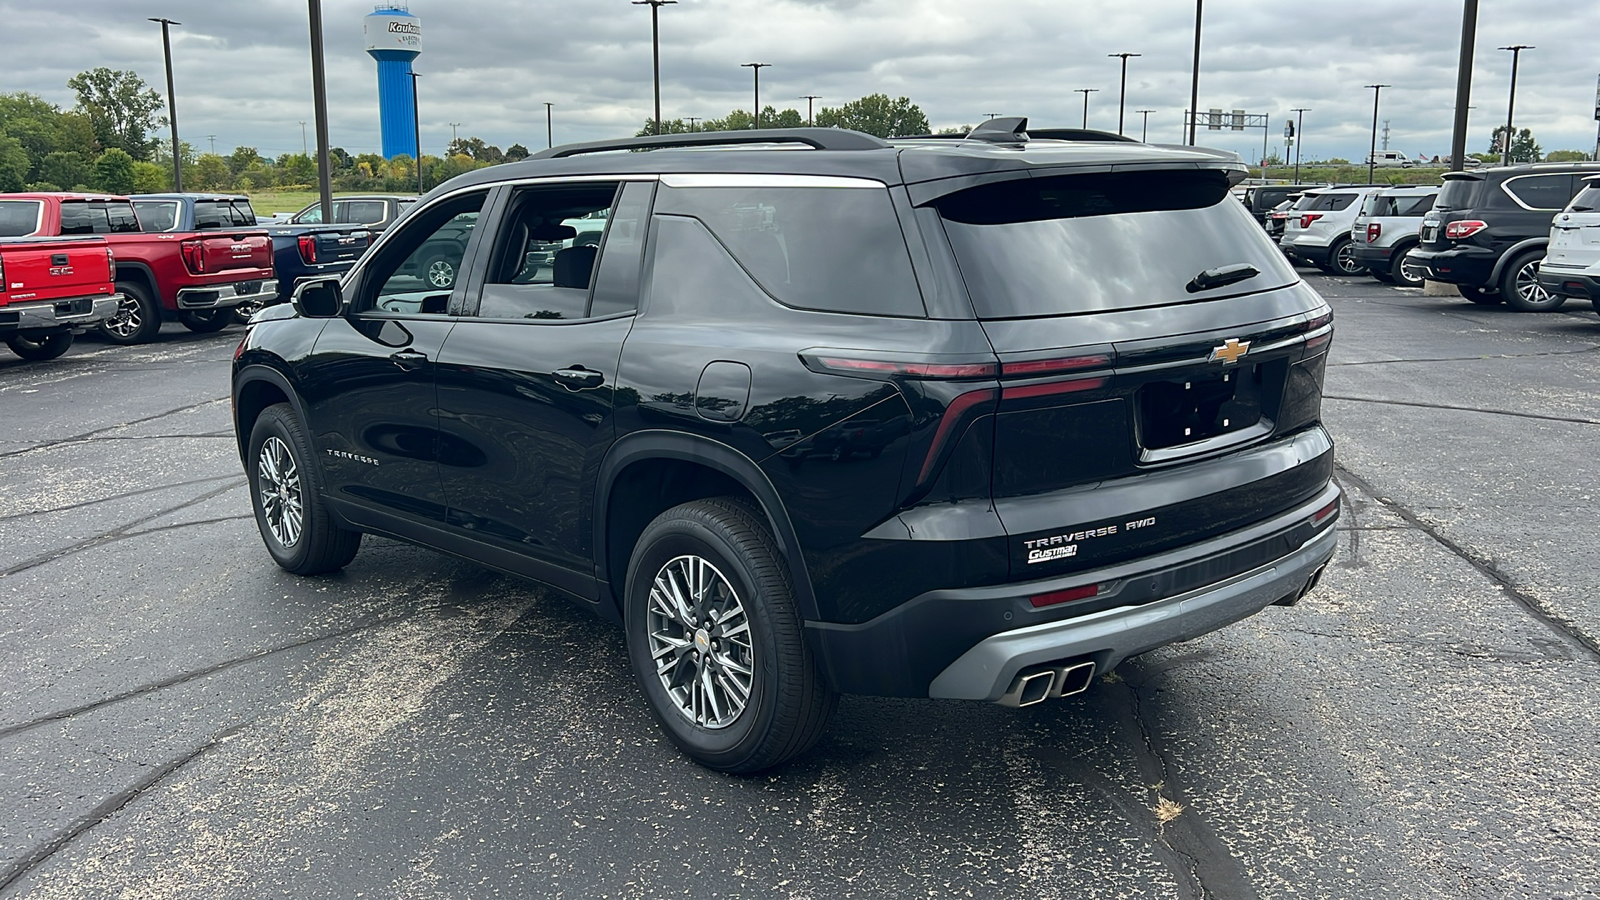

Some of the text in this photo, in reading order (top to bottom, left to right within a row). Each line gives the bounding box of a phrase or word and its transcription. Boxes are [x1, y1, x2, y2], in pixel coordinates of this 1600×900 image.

[326, 448, 380, 466] TRAVERSE
[1023, 516, 1156, 549] TRAVERSE AWD
[1028, 544, 1078, 560] Gustman
